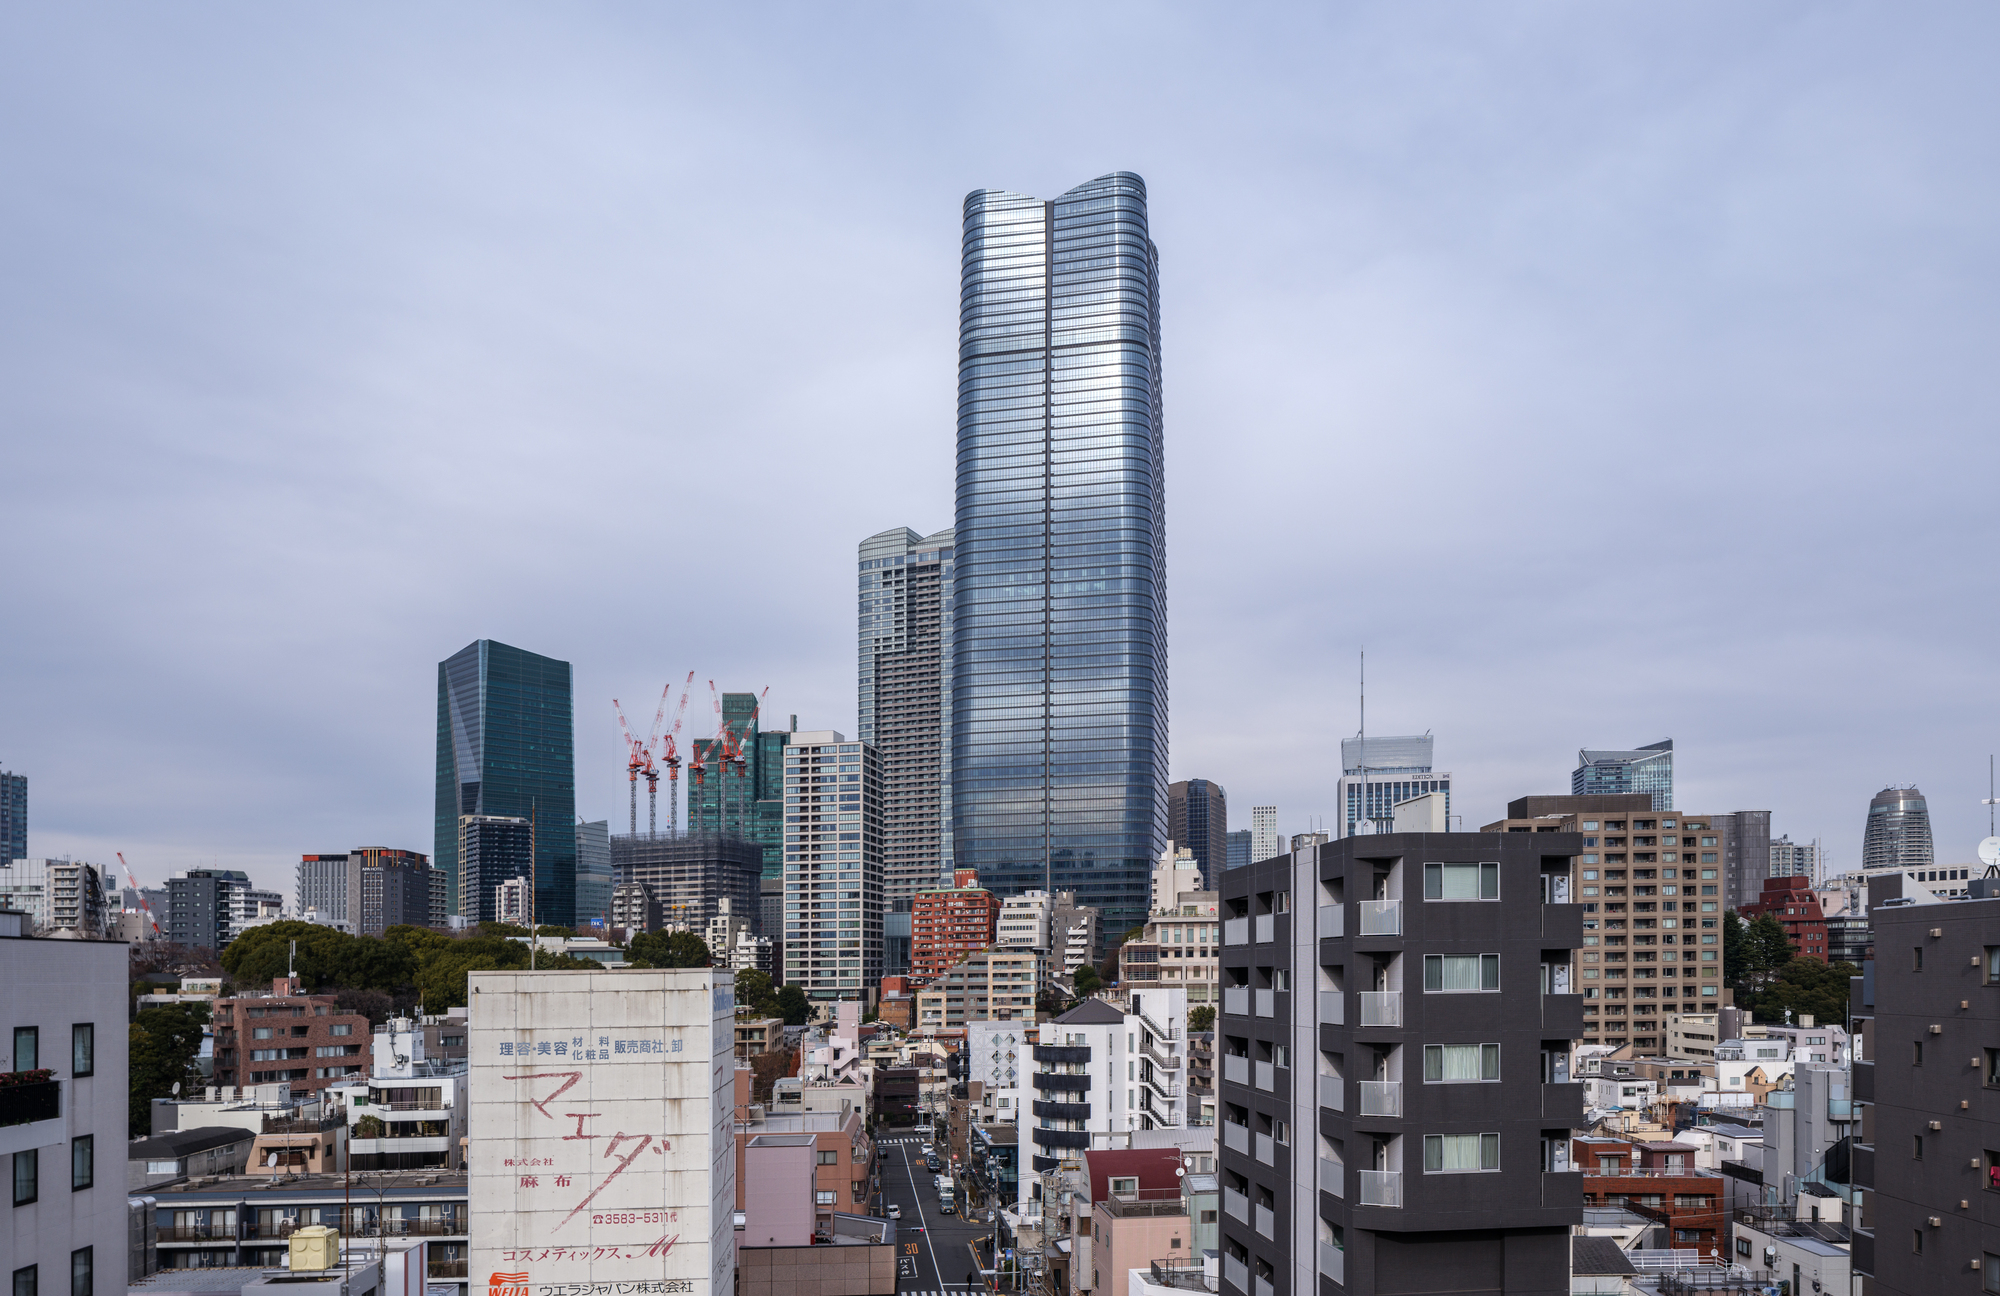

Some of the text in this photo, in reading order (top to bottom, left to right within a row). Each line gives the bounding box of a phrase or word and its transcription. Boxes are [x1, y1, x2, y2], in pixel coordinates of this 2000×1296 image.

[504, 1157, 554, 1167] 株式会社
[904, 1243, 919, 1255] 30
[539, 1281, 694, 1296] ウエラジャパン株式会社
